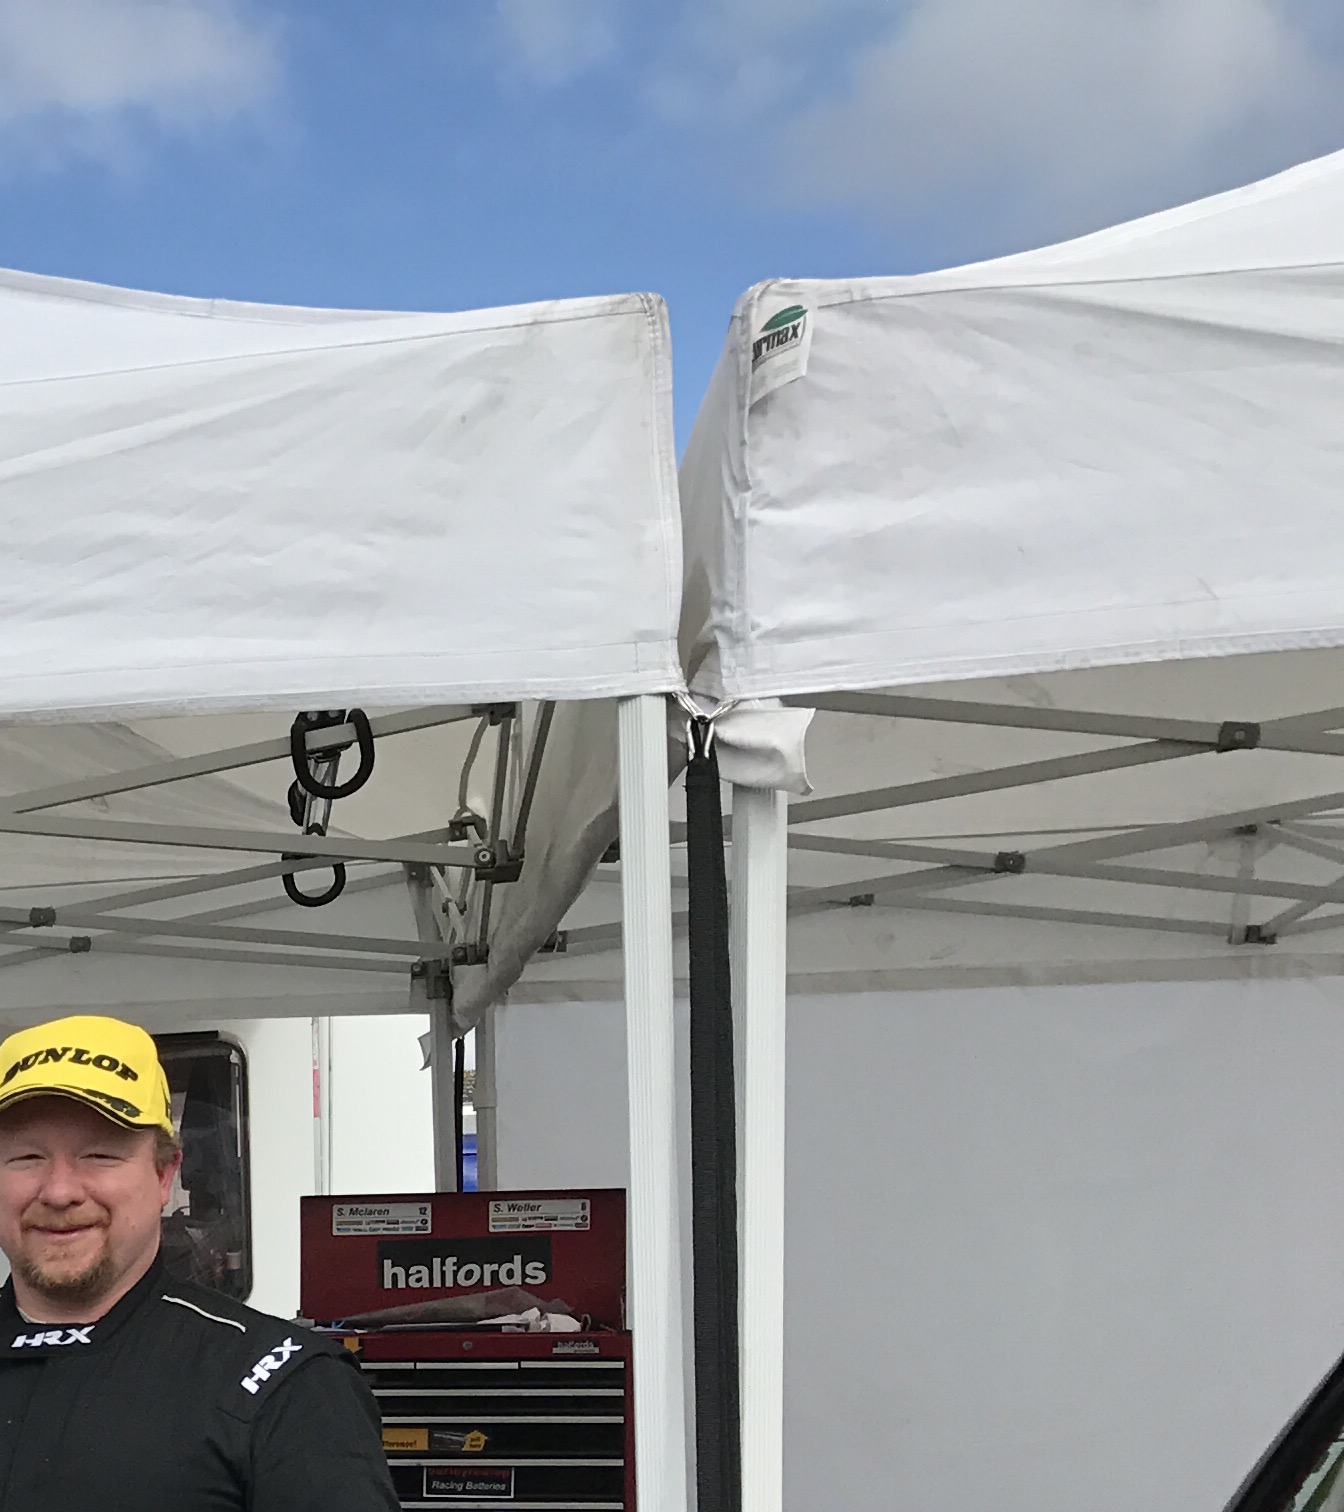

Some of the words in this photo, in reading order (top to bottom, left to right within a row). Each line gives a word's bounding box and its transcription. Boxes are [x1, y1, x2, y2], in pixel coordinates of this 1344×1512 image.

[0, 1046, 139, 1088] DUNLOP
[383, 1255, 547, 1289] halfords
[10, 1325, 97, 1348] HRX
[241, 1337, 303, 1395] HRX
[431, 1480, 463, 1491] Racing
[465, 1481, 506, 1491] Batteries
